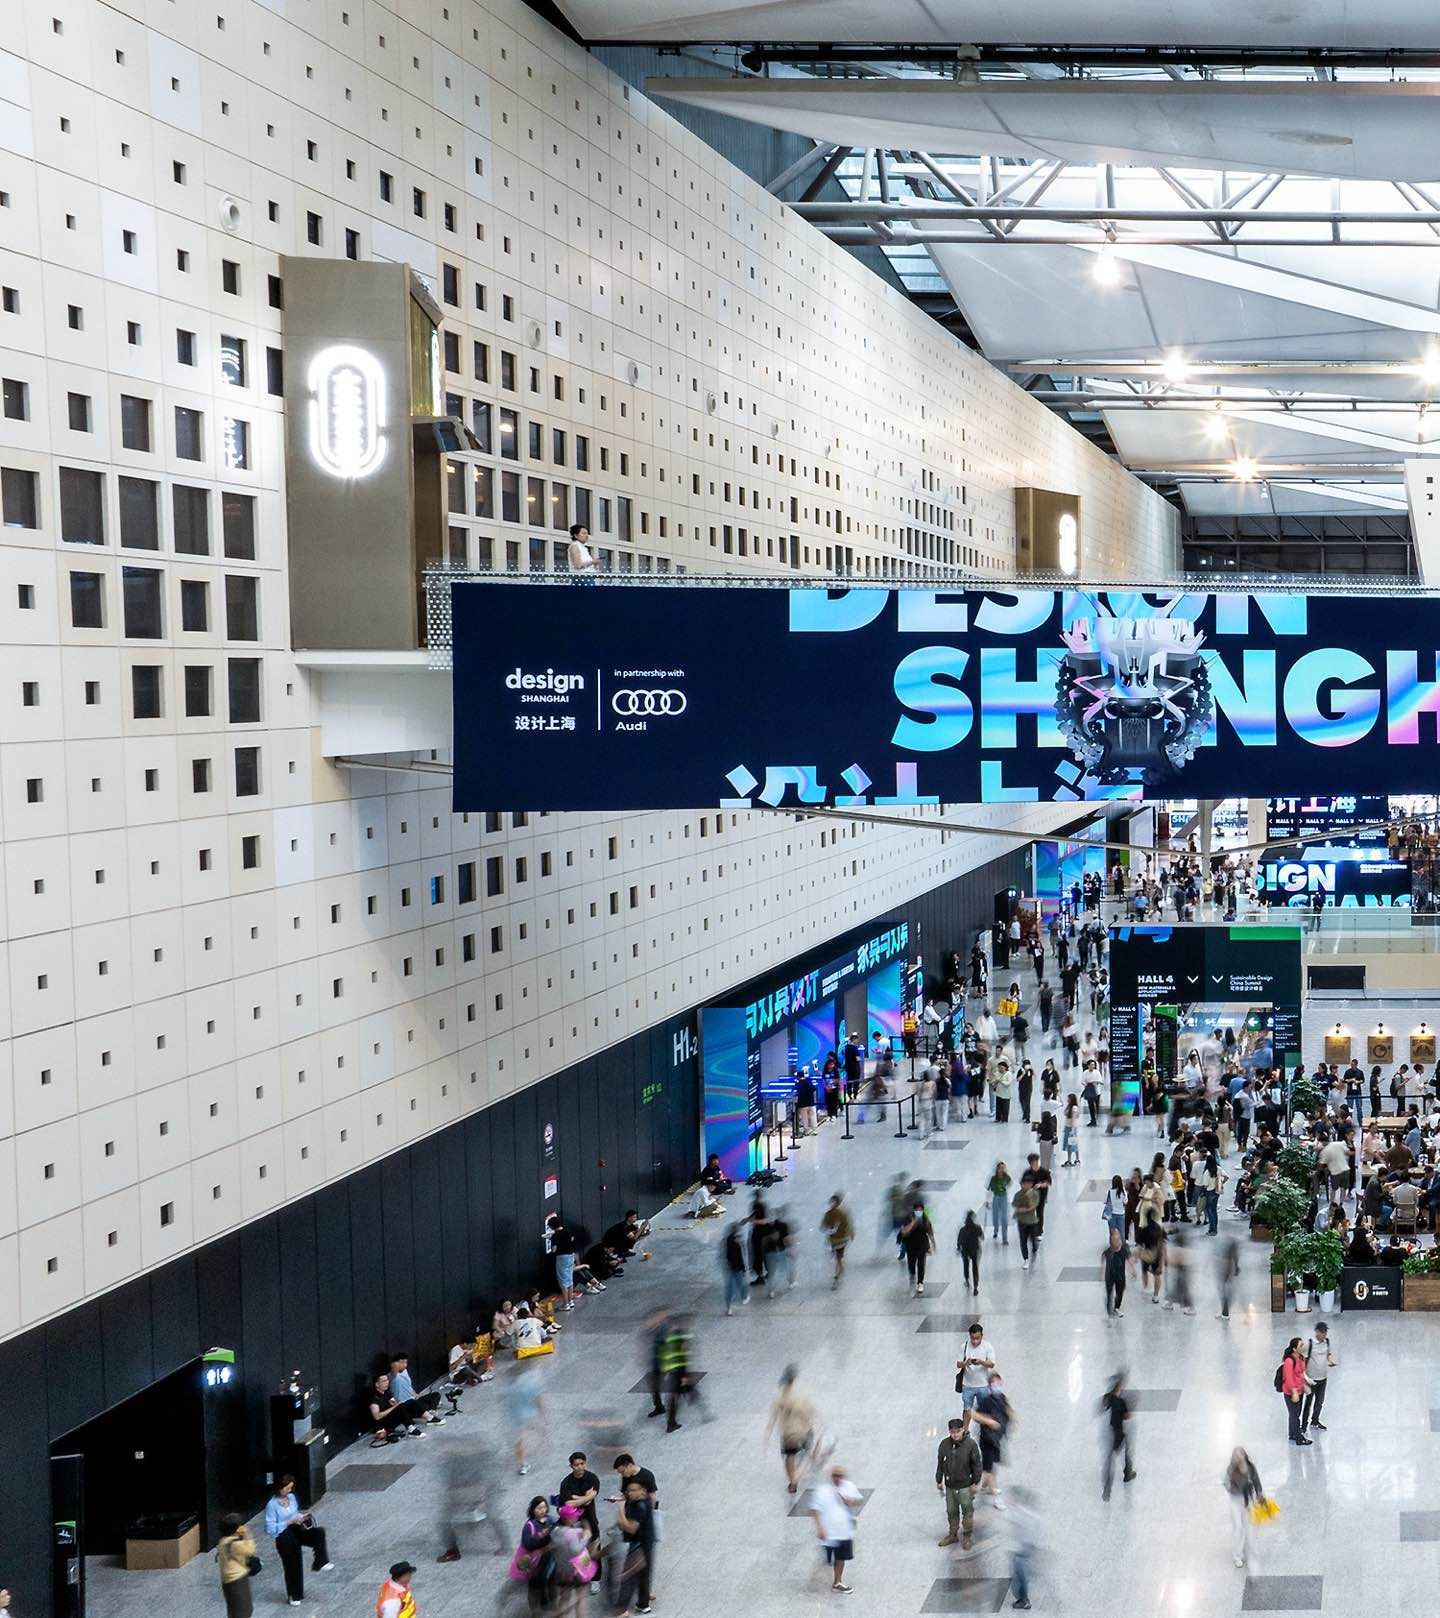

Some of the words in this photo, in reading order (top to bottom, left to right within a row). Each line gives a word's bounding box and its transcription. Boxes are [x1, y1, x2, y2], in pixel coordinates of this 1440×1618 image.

[614, 669, 622, 677] in
[623, 669, 667, 679] partnership
[667, 669, 685, 677] with
[505, 667, 585, 694] design
[521, 695, 570, 703] SHANGHAI
[514, 715, 576, 731] 设计上海
[615, 721, 647, 731] Audi
[1137, 975, 1165, 984] HALL
[1165, 975, 1174, 984] 4
